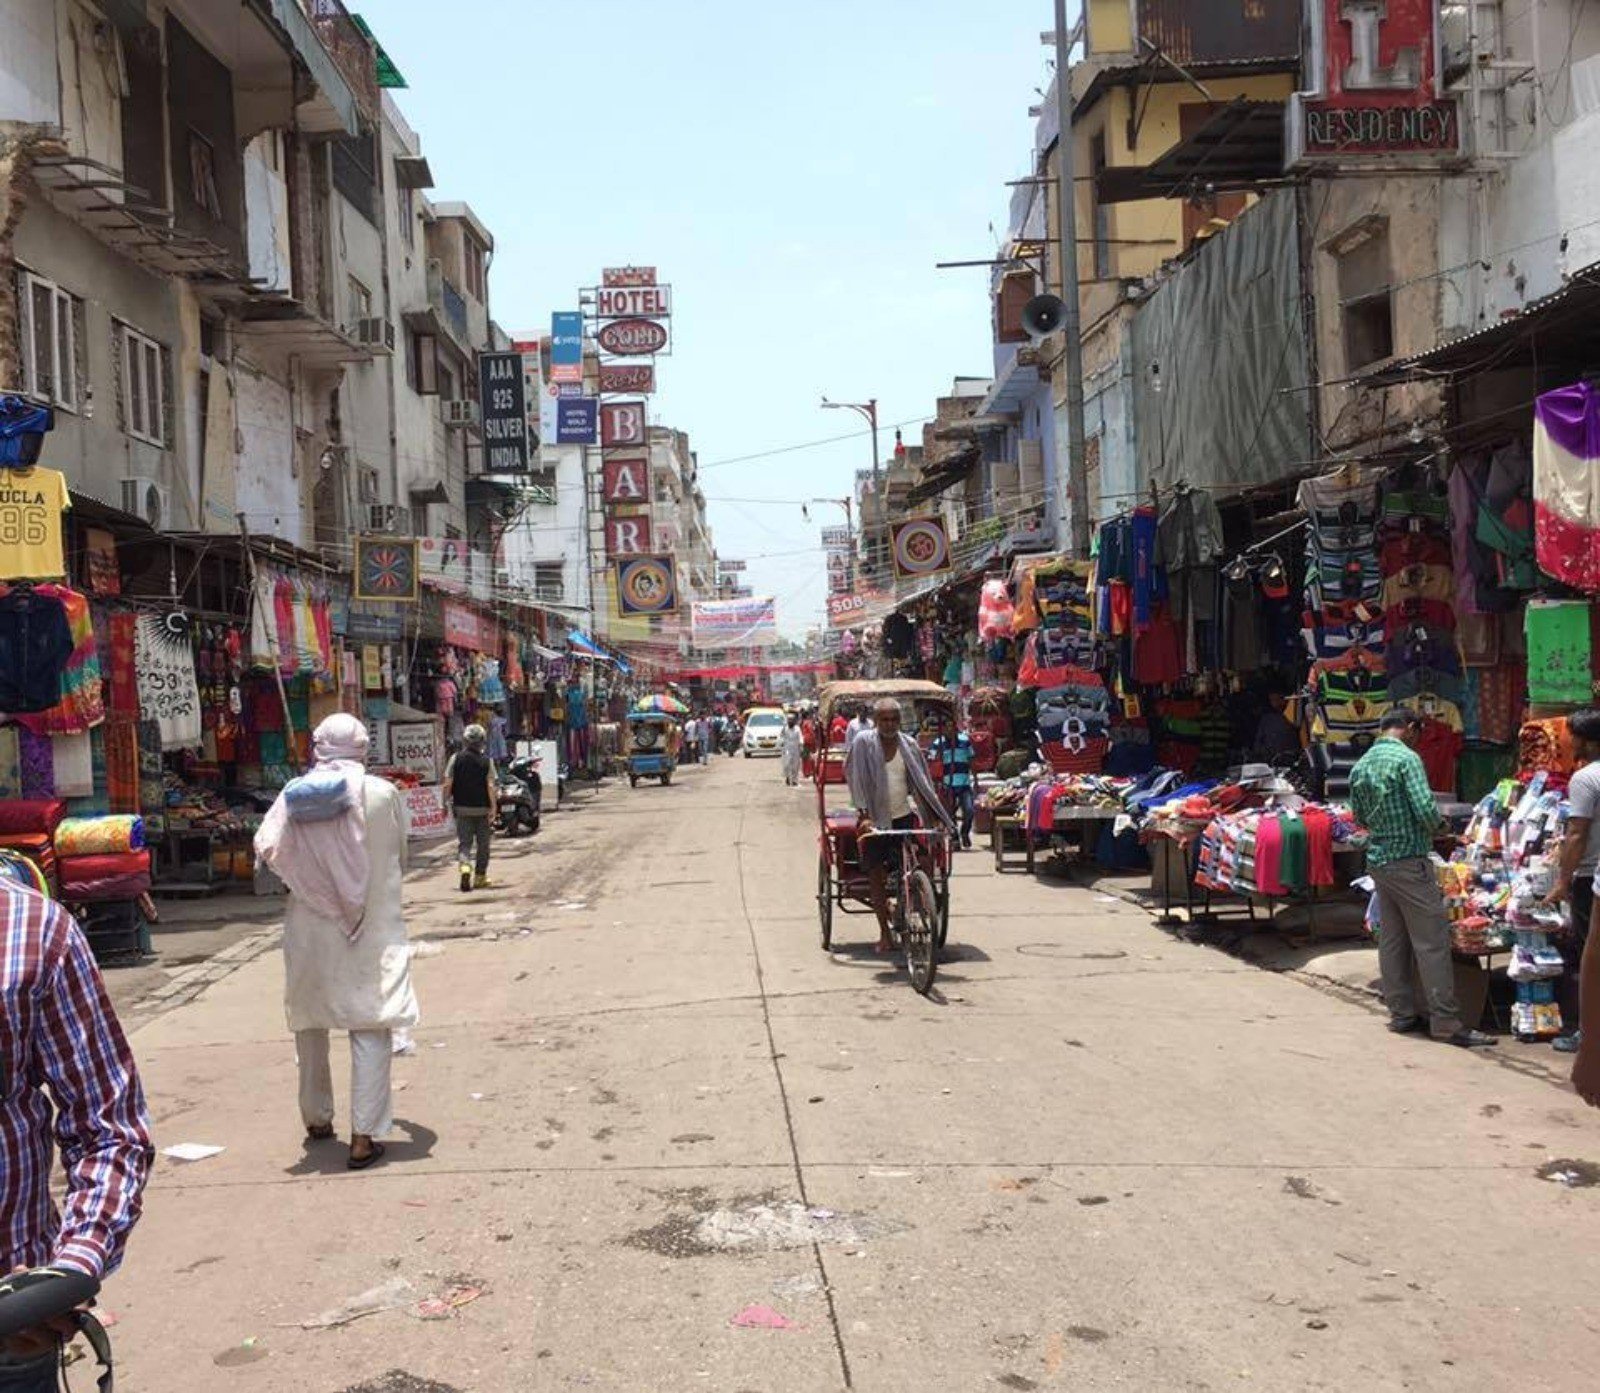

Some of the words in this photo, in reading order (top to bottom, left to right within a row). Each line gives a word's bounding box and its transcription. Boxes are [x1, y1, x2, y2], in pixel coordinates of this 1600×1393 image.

[1307, 109, 1451, 143] RESIDENCY
[599, 290, 667, 313] HOTEL
[489, 360, 513, 380] AAA
[493, 388, 514, 409] 925
[486, 418, 523, 439] SILVER
[491, 448, 520, 468] INDIA
[0, 491, 44, 503] UCLA
[0, 506, 46, 544] 86
